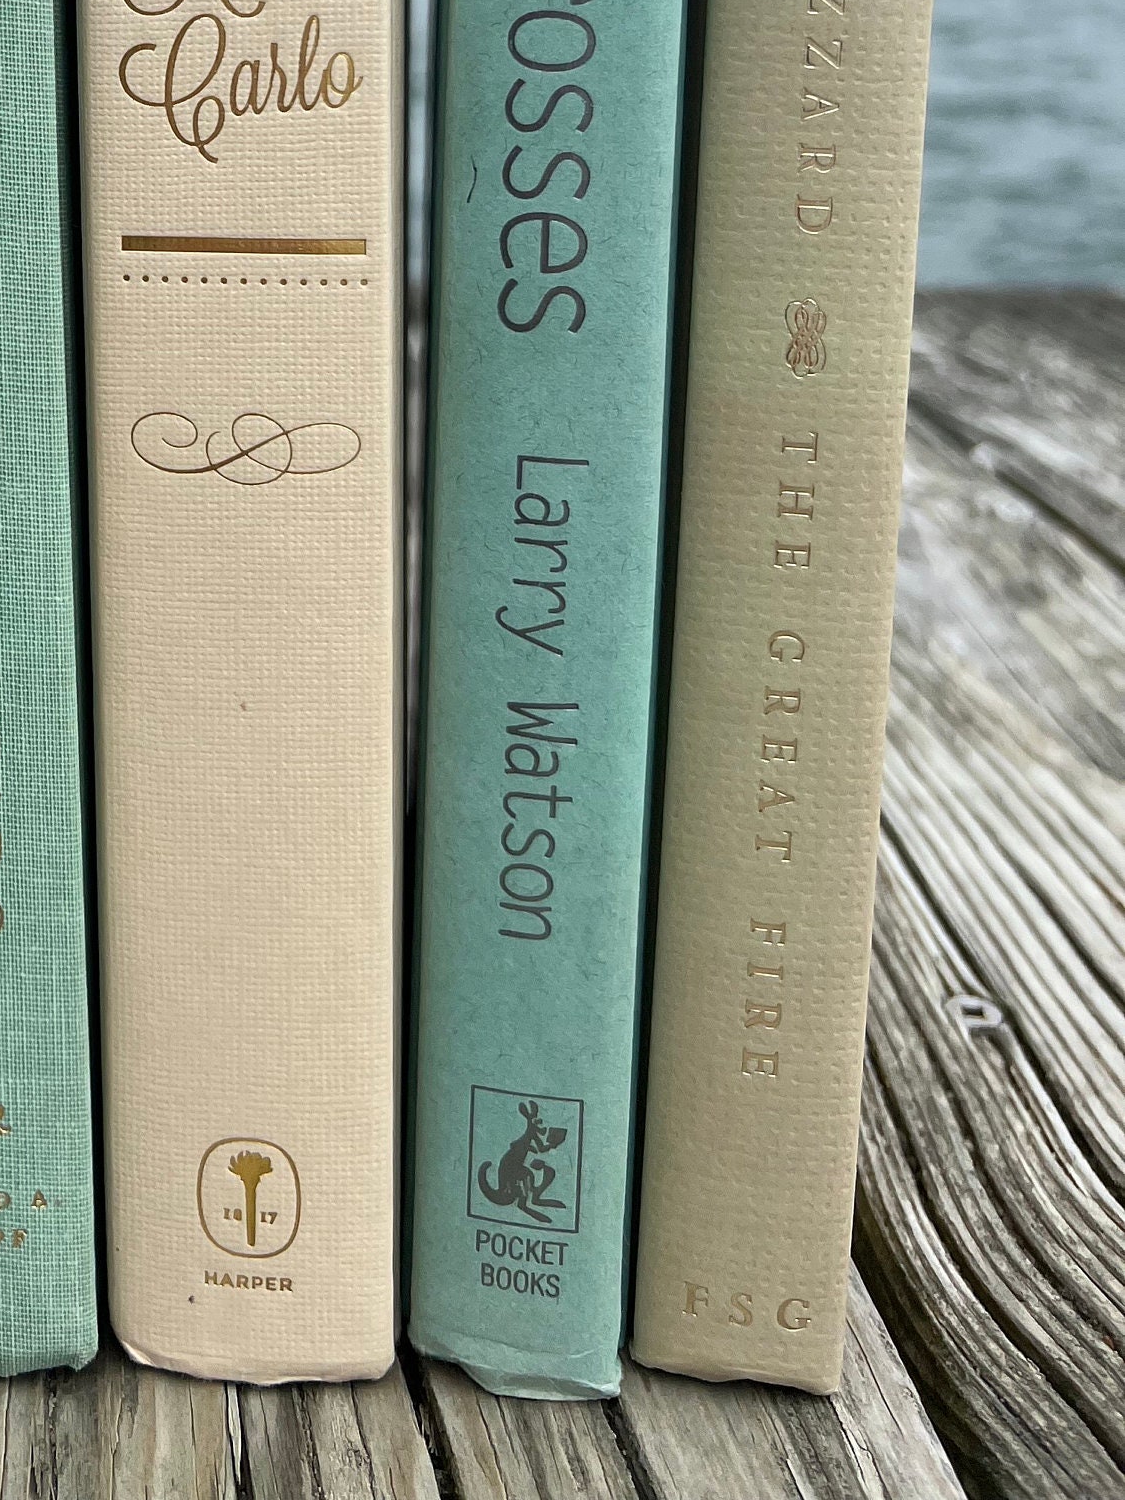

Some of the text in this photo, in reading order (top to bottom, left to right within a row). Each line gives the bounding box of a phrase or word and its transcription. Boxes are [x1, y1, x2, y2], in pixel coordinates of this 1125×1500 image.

[118, 13, 364, 164] Carlo
[495, 455, 589, 657] Larry
[774, 431, 818, 569] THE
[755, 630, 806, 861] GREAT
[498, 702, 579, 941] Watson
[741, 917, 787, 1079] FIRE
[203, 1269, 294, 1293] HARPER
[475, 1228, 569, 1266] POCKET
[480, 1262, 561, 1299] BOOKS
